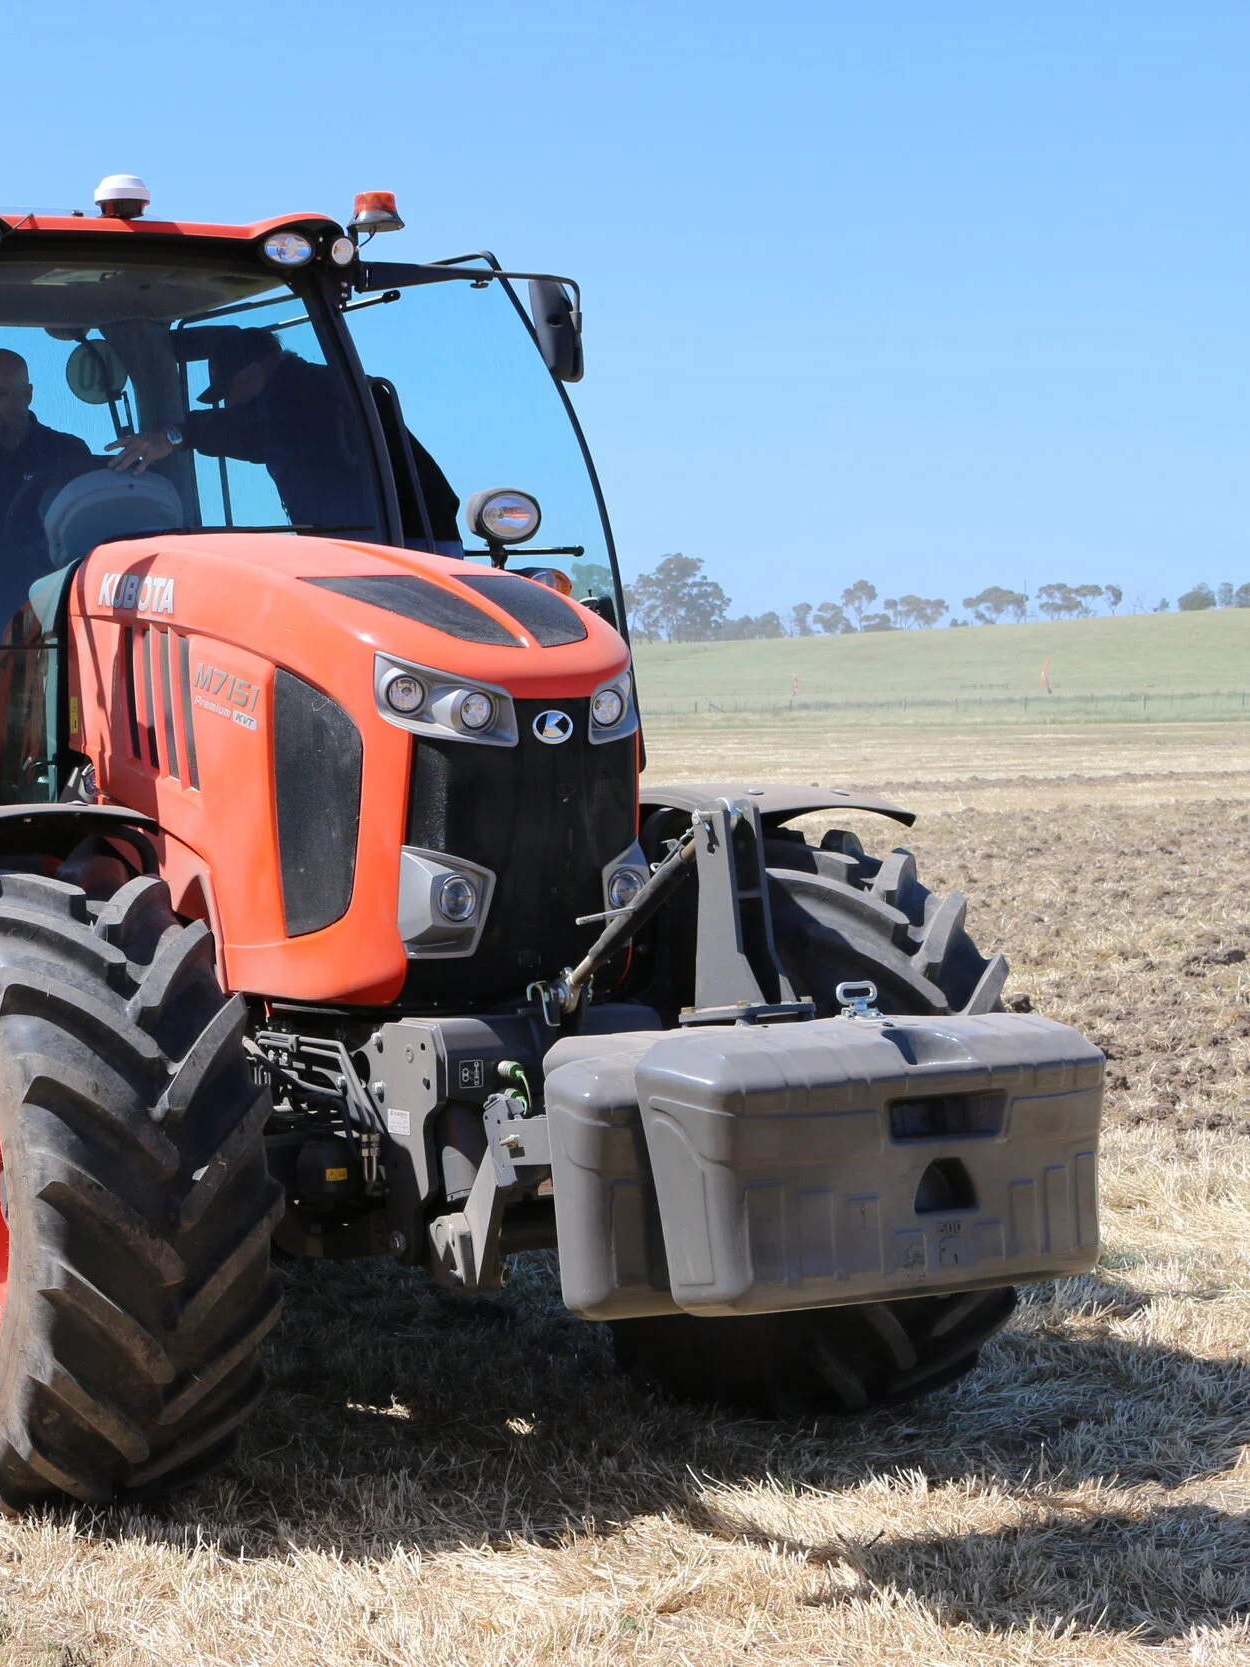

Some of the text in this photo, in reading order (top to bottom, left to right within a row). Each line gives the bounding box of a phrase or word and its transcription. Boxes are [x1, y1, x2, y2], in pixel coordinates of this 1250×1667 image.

[98, 573, 174, 614] KUBOTA
[194, 662, 260, 712] M7151
[193, 694, 256, 728] Premium KVT
